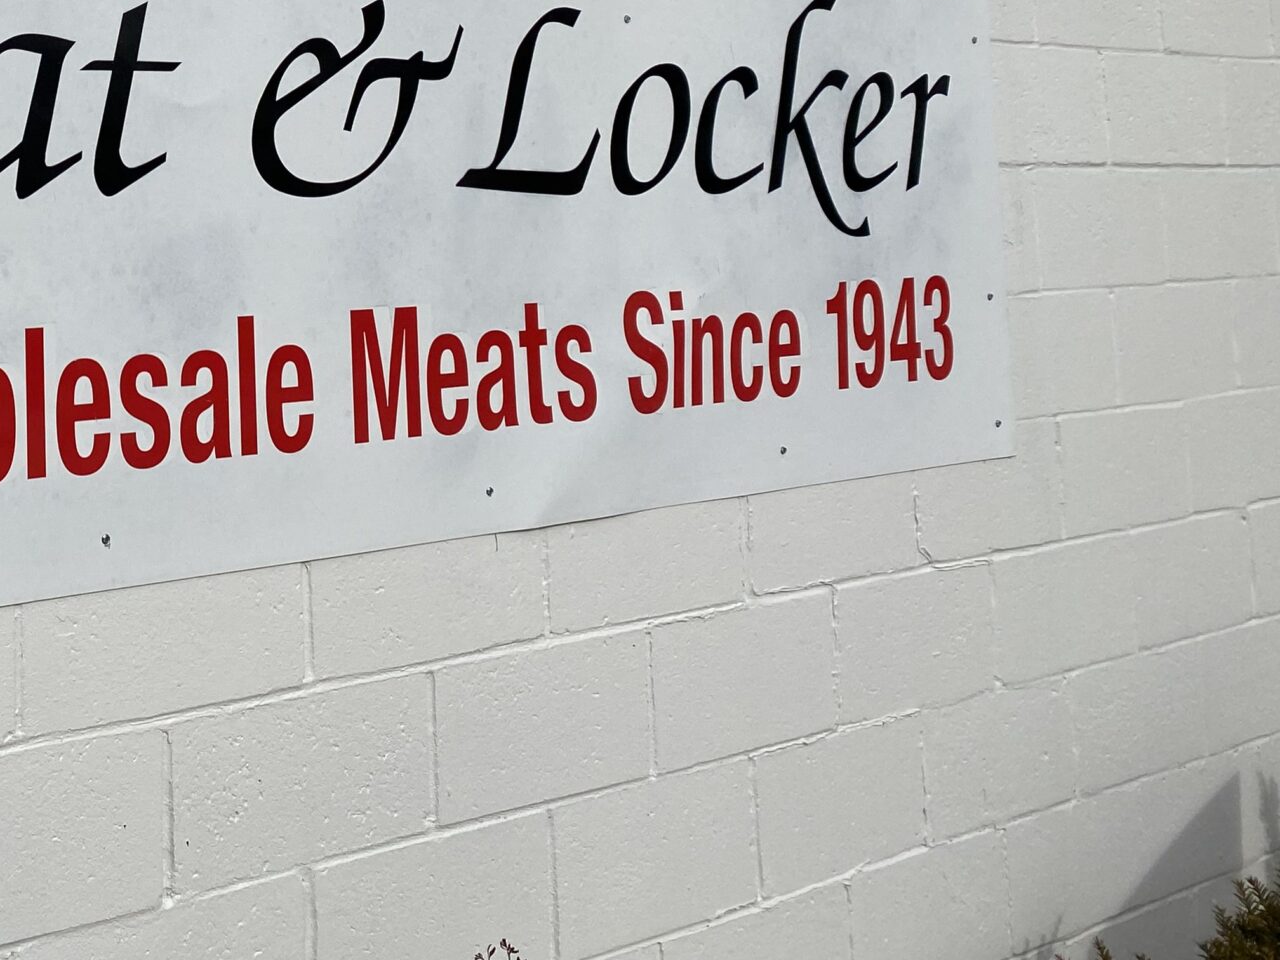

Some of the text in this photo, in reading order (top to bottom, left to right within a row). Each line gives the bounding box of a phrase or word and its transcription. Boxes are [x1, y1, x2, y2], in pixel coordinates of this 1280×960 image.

[350, 303, 598, 444] Meats
[623, 290, 802, 415] Since
[825, 275, 954, 390] 1943
